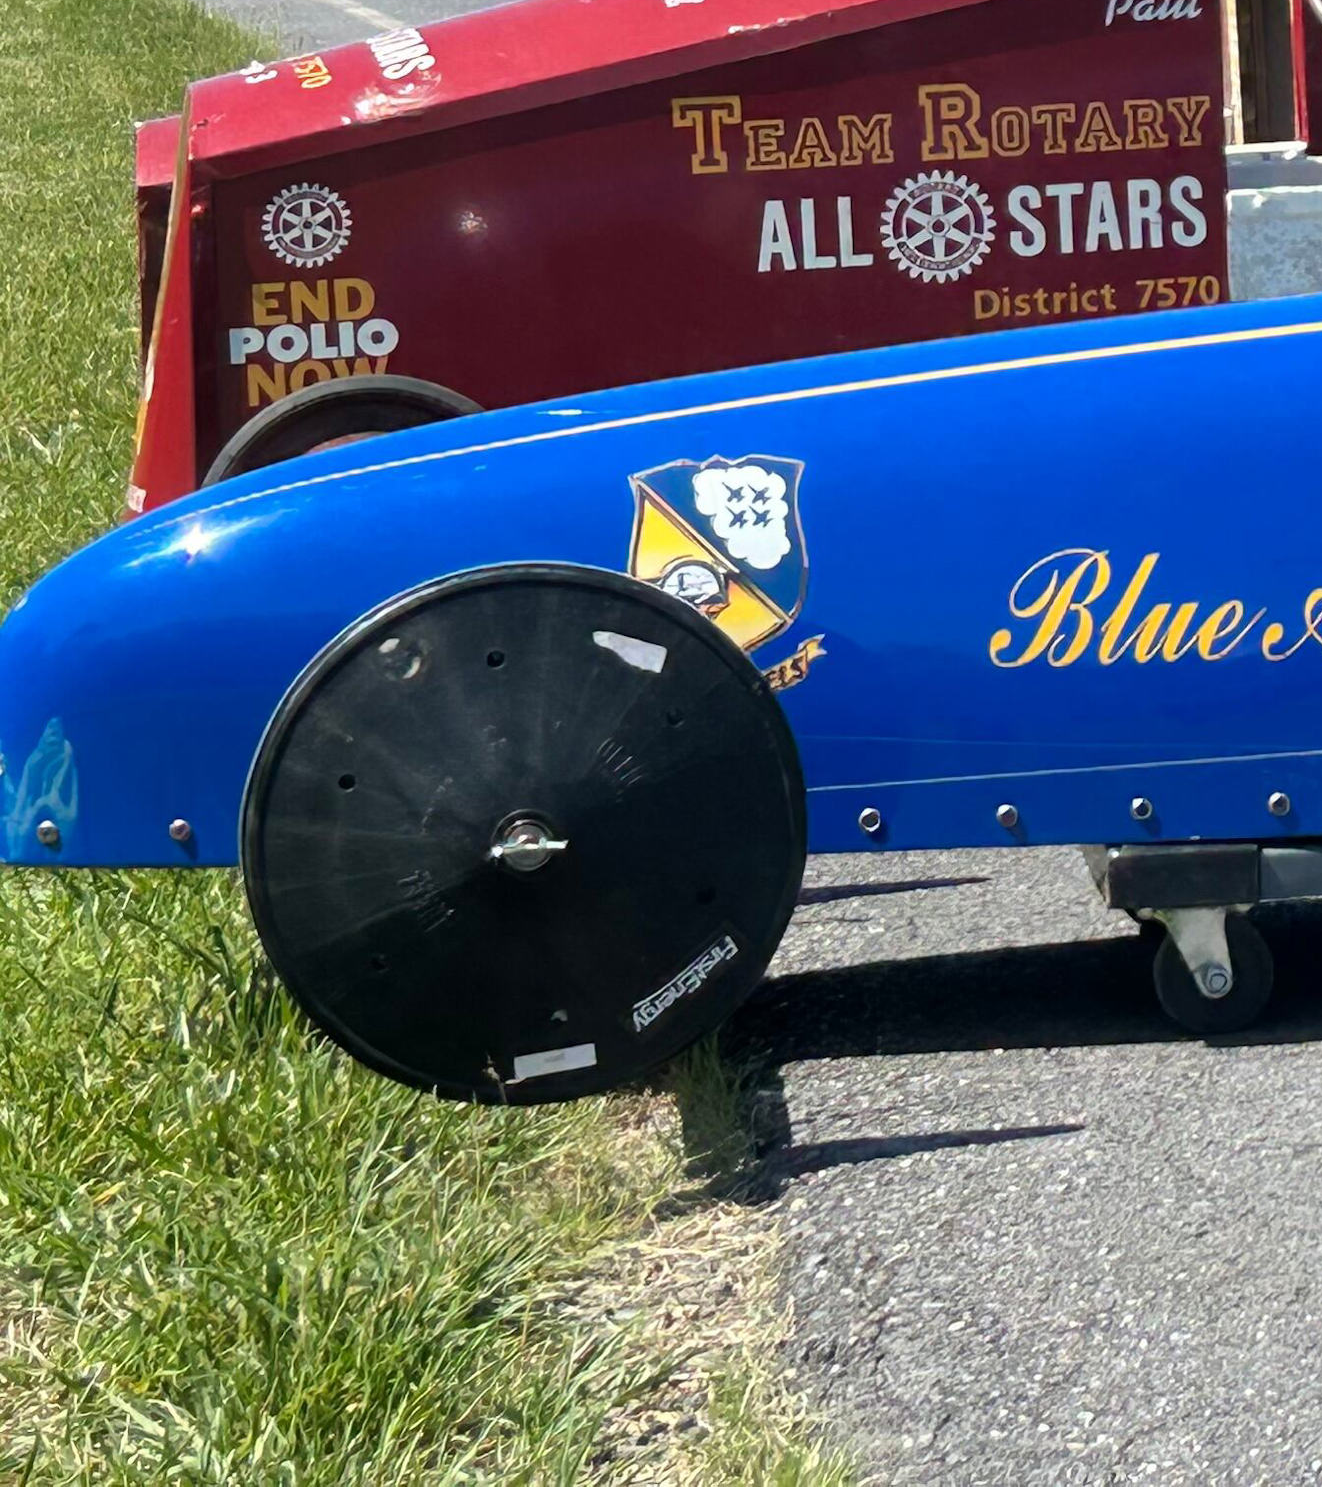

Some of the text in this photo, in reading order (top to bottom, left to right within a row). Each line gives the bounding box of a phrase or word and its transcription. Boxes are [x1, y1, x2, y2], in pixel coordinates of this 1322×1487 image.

[671, 83, 1211, 174] TEAM ROTARY
[757, 175, 1208, 273] ALL STARS
[229, 318, 399, 364] POLIO
[252, 278, 375, 326] END
[974, 275, 1221, 320] District 7570
[990, 547, 1266, 668] Blue
[632, 935, 739, 1032] FirstEnergy
